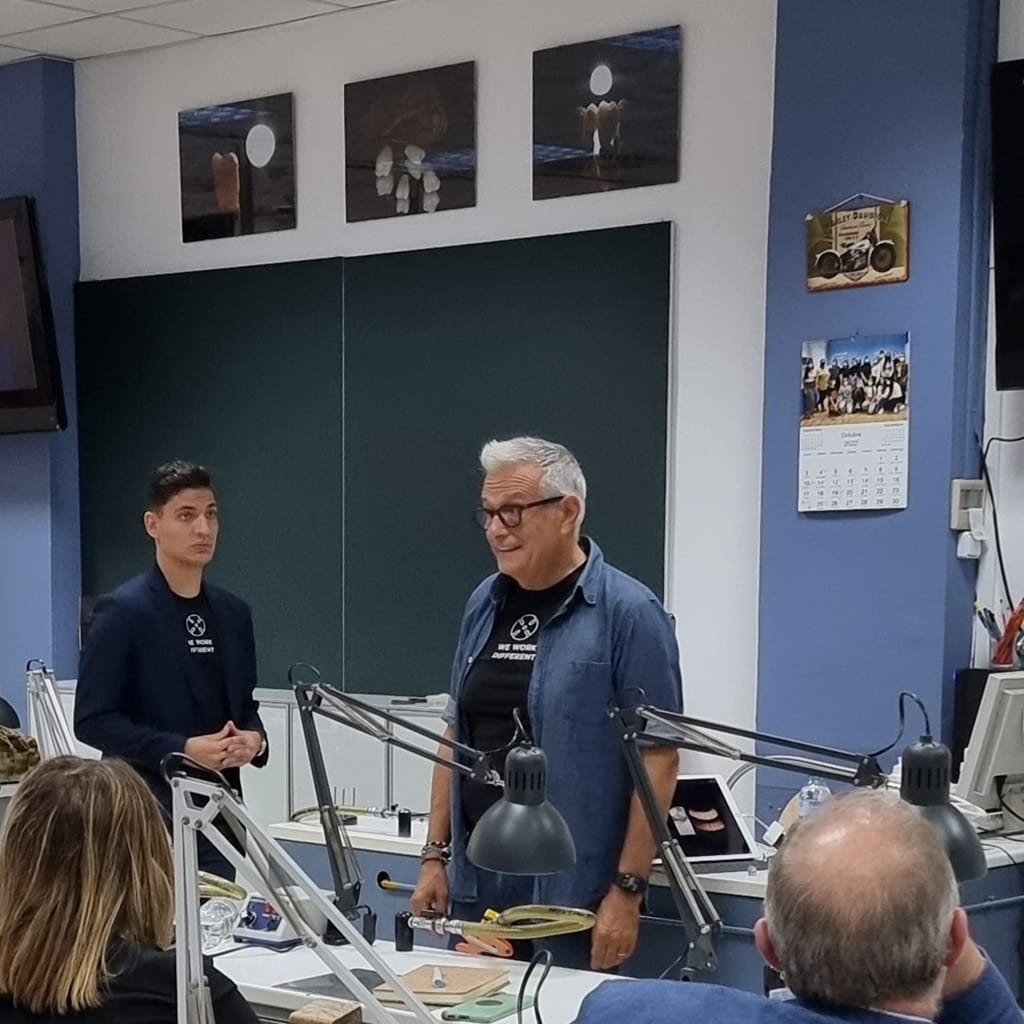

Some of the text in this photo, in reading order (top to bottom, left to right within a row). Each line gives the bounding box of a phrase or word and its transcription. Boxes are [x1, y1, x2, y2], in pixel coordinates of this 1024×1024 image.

[498, 643, 537, 652] WE WORK
[491, 651, 537, 661] DIFFERENT
